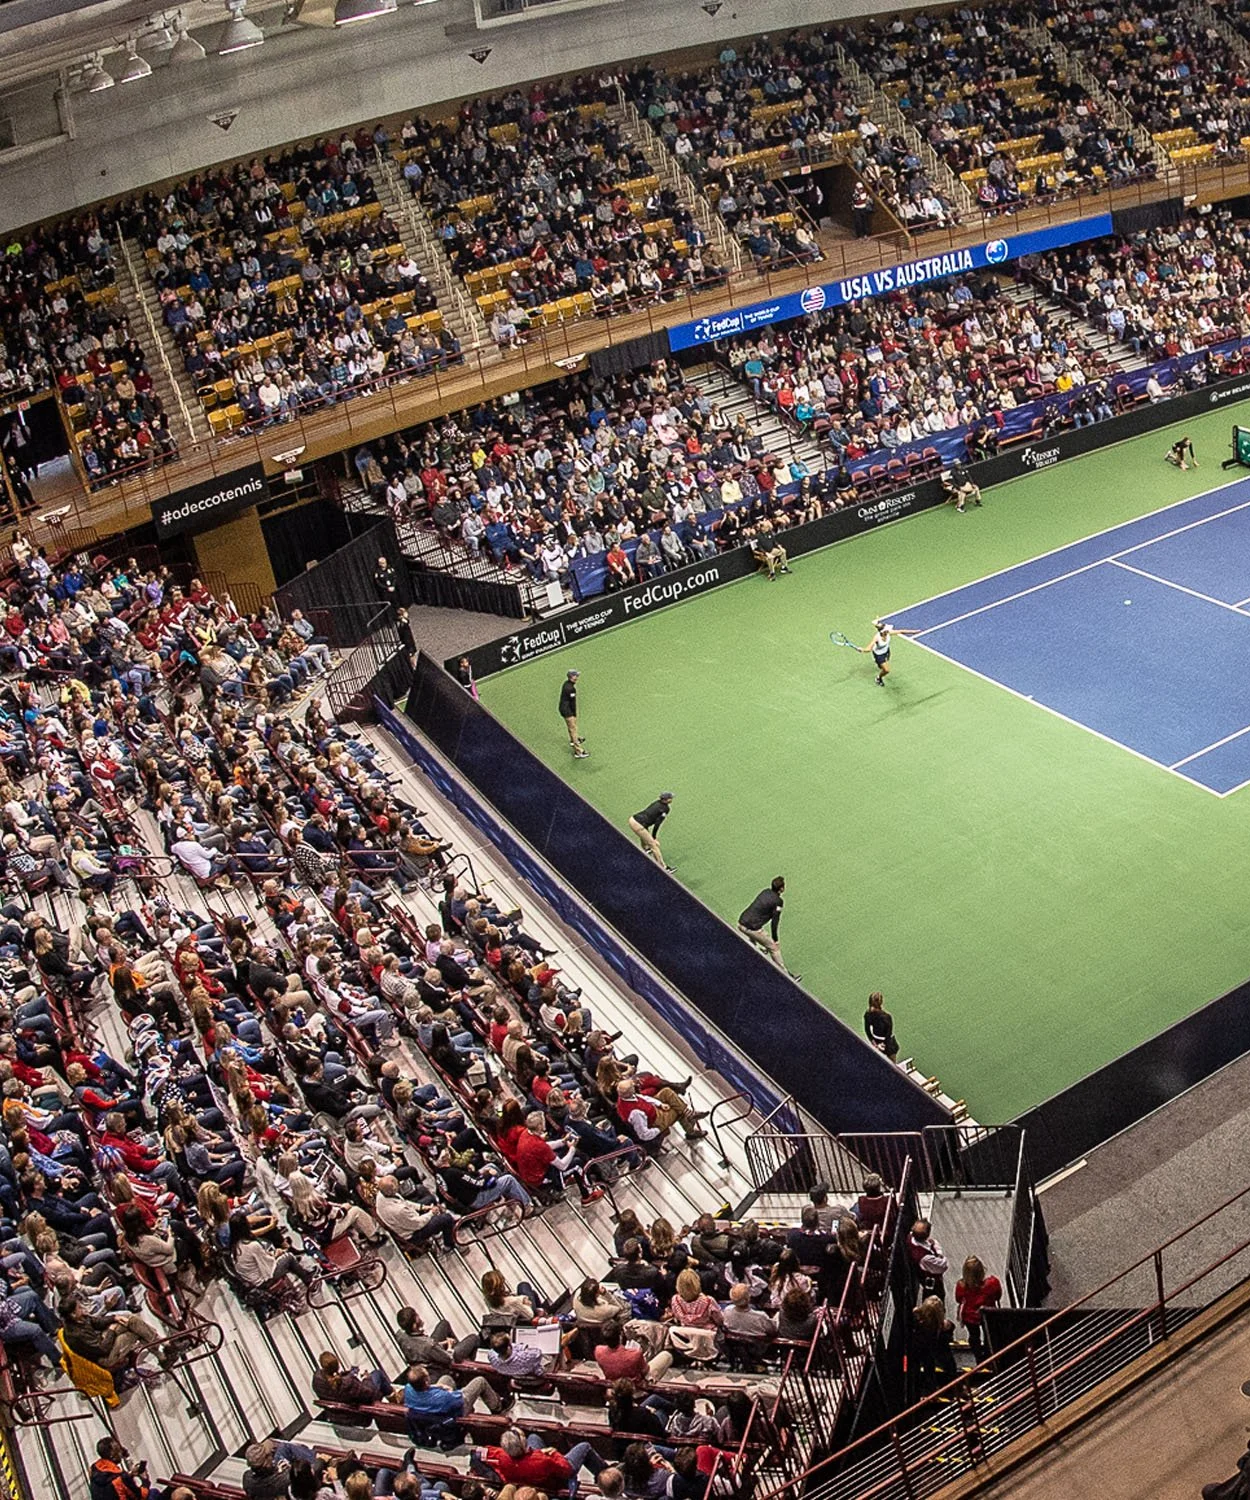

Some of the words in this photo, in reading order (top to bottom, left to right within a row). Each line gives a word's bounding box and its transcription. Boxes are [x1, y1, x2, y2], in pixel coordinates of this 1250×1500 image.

[840, 276, 873, 300] USA
[874, 269, 894, 293] VS
[896, 249, 973, 288] AUSTRALIA
[711, 317, 740, 332] FedCup
[1218, 390, 1231, 398] NEW
[1031, 446, 1060, 464] MISSION
[160, 477, 263, 526] #adeccotennis
[885, 492, 916, 509] RESORTS
[623, 566, 720, 614] FedCup.com
[565, 621, 578, 631] THE
[578, 613, 600, 625] WORLD
[600, 608, 613, 618] CUP
[523, 629, 560, 651] FedCup
